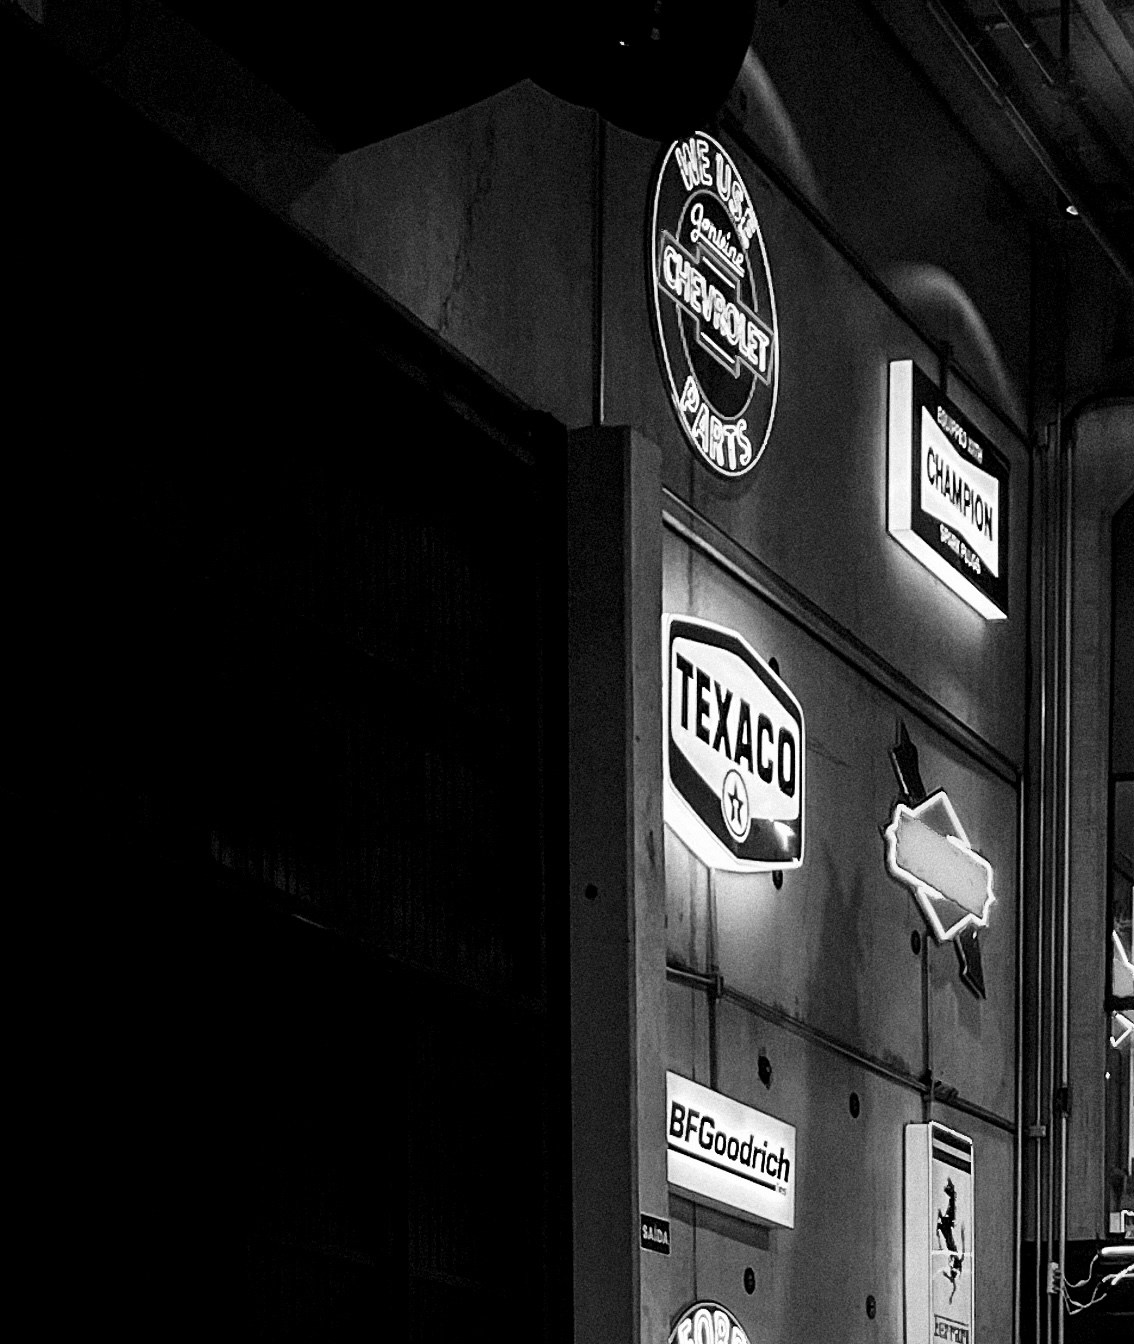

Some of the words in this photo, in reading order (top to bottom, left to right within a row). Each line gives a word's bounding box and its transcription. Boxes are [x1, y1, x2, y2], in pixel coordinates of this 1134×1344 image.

[675, 137, 713, 191] WE
[663, 244, 770, 373] CHEVROLET
[679, 375, 752, 471] PARTS
[926, 446, 994, 542] CHAMPION
[675, 651, 797, 799] TEXACO
[669, 1100, 791, 1183] BFGoodrich
